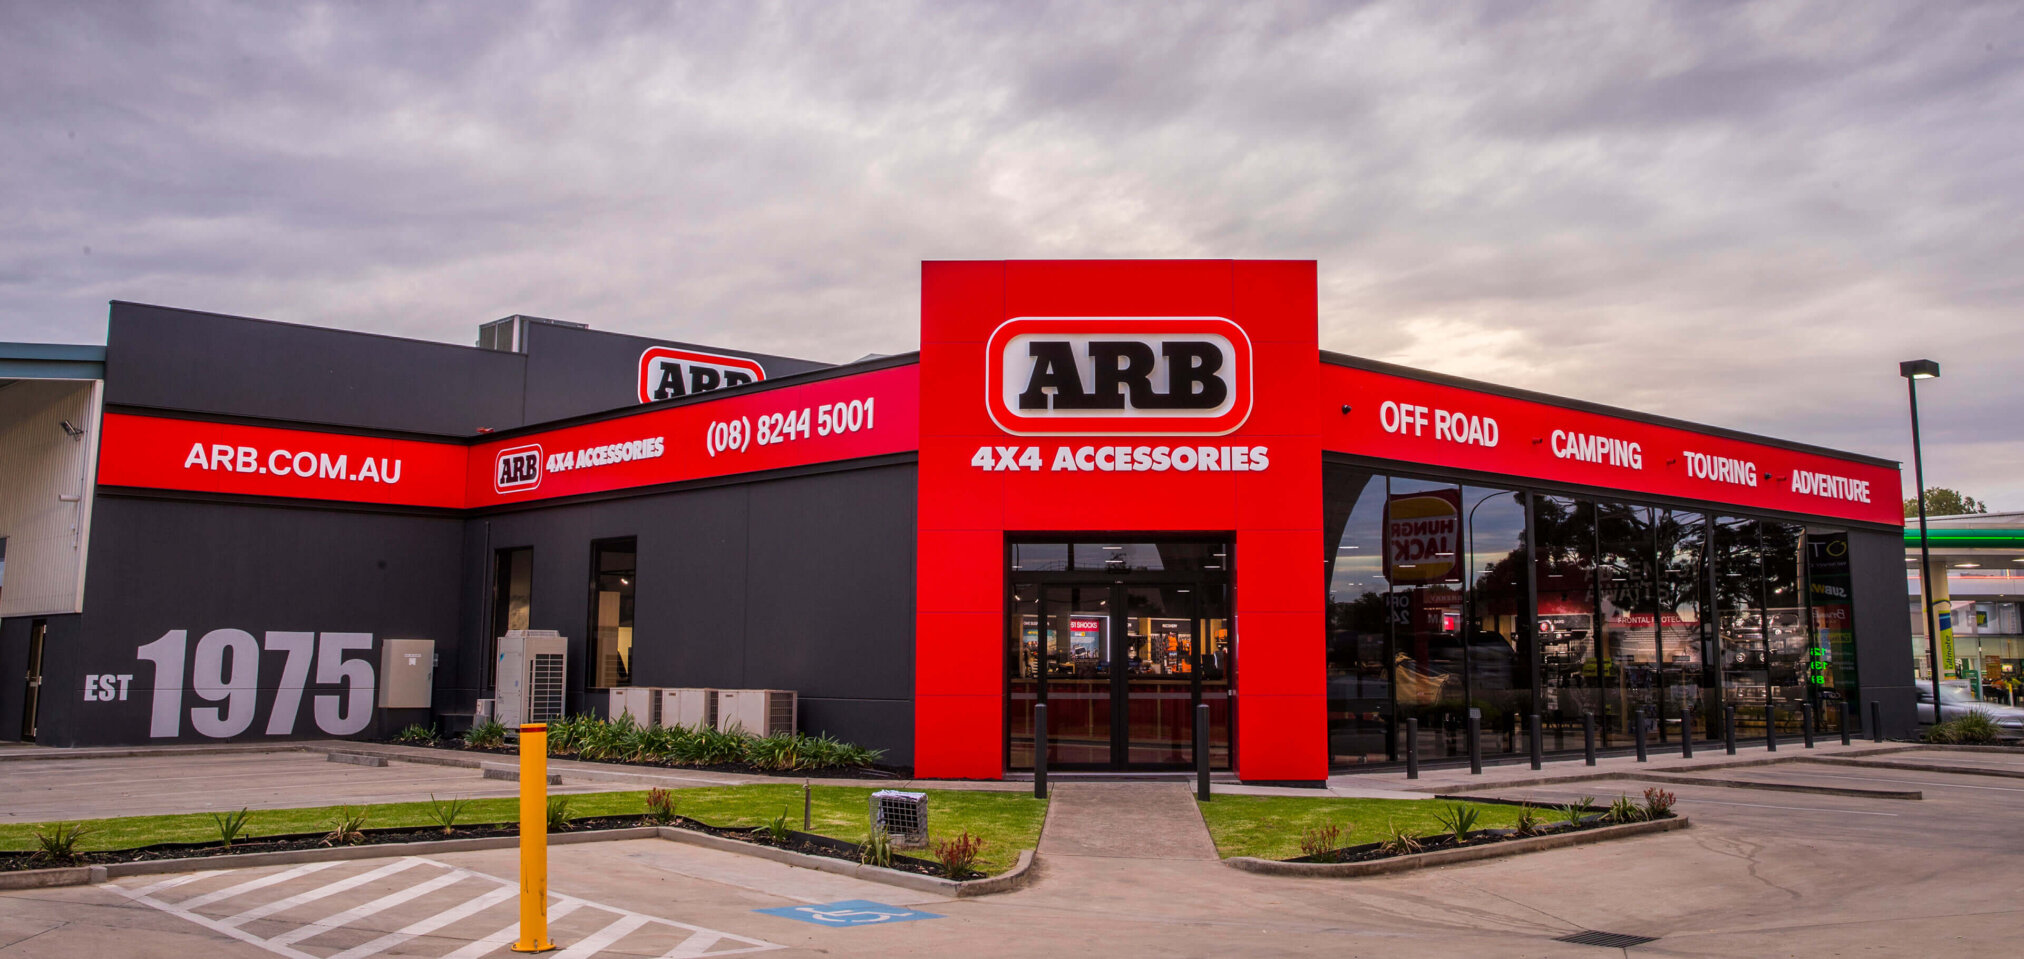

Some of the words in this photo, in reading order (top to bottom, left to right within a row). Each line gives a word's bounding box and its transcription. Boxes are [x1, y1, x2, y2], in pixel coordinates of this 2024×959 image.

[1019, 341, 1228, 410] ARB
[706, 415, 751, 458] (08)
[757, 407, 811, 446] 8244
[817, 397, 875, 436] 5001
[1379, 400, 1429, 437] OFF
[1434, 409, 1499, 448] ROAD
[184, 442, 402, 485] ARB.COM.AU
[546, 451, 575, 473] 4X4
[575, 436, 665, 470] ACCESSORIES
[971, 446, 1043, 471] 4X4
[1051, 445, 1270, 472] ACCESSORIES
[1551, 429, 1643, 470] CAMPING
[499, 453, 539, 485] ARB
[1683, 450, 1757, 487] TOURING
[1791, 469, 1871, 504] ADVENTURE
[1077, 621, 1098, 629] SHOCKS
[1617, 616, 1650, 624] FRONTAL
[83, 674, 134, 702] EST
[137, 628, 376, 738] 1975
